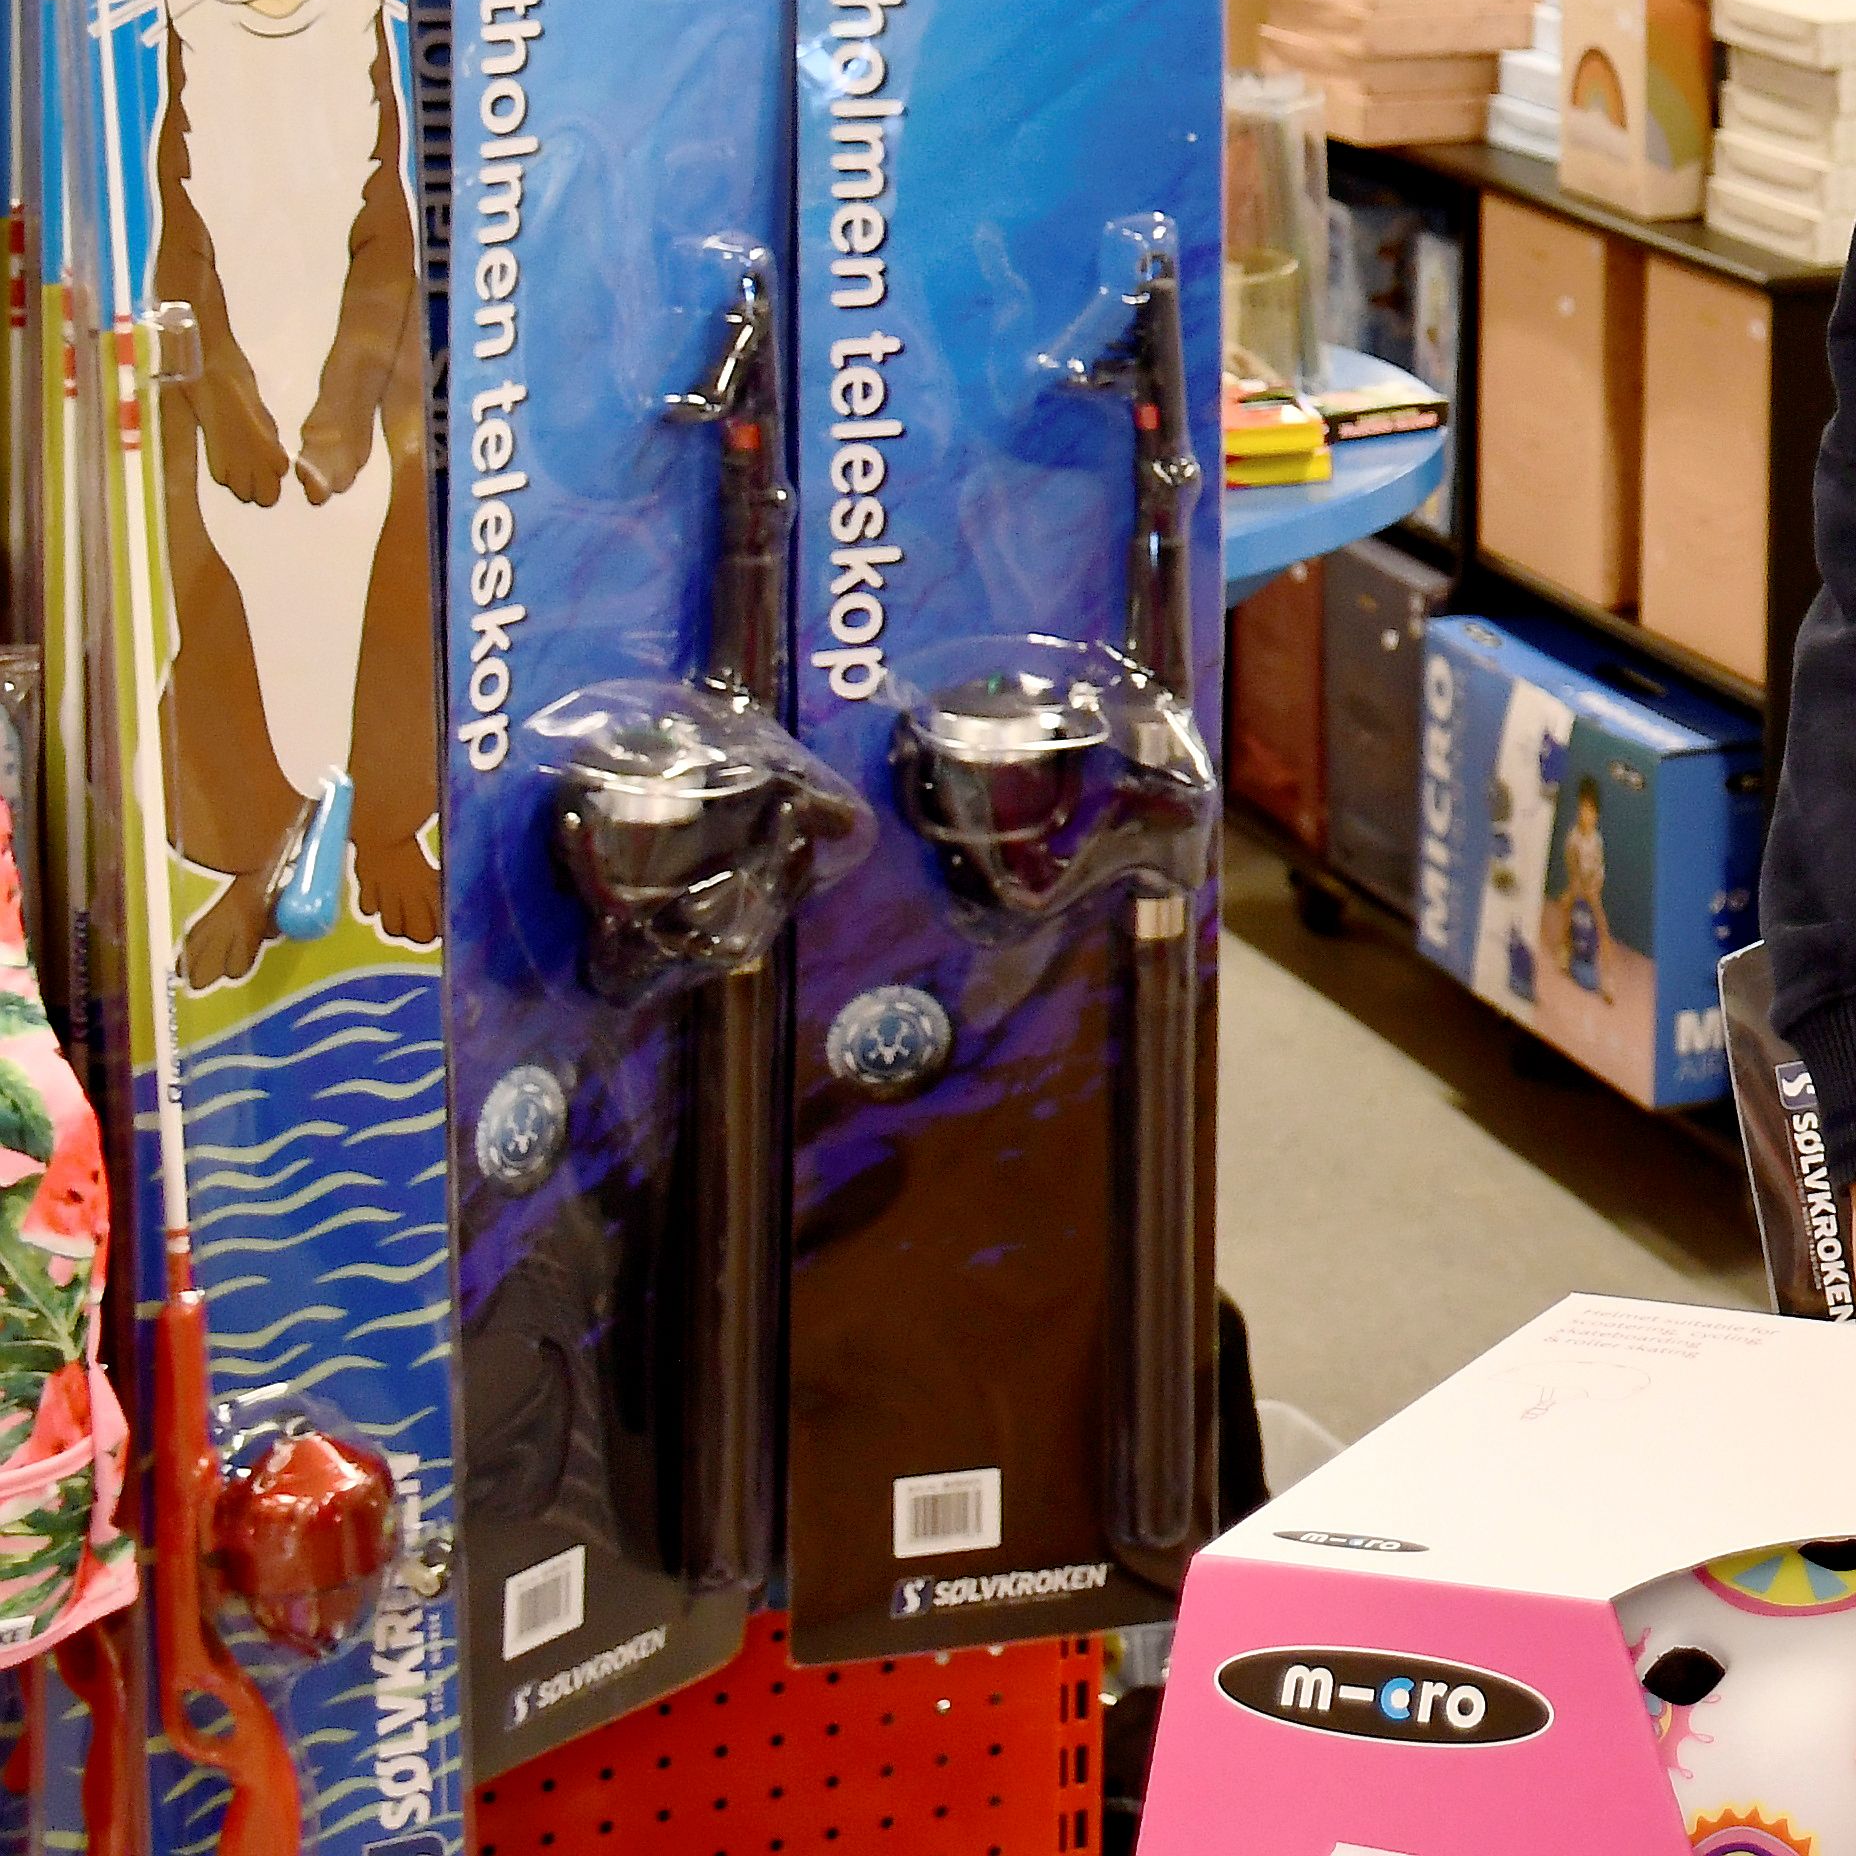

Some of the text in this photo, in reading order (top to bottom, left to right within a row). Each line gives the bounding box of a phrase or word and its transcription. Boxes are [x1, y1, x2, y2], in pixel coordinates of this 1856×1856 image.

[457, 377, 530, 772] teleskop
[812, 328, 904, 701] teleskop
[1420, 655, 1459, 945] MICRO
[537, 1624, 667, 1710] SØLVKROKEN
[932, 1563, 1108, 1607] SØLVKROKEN
